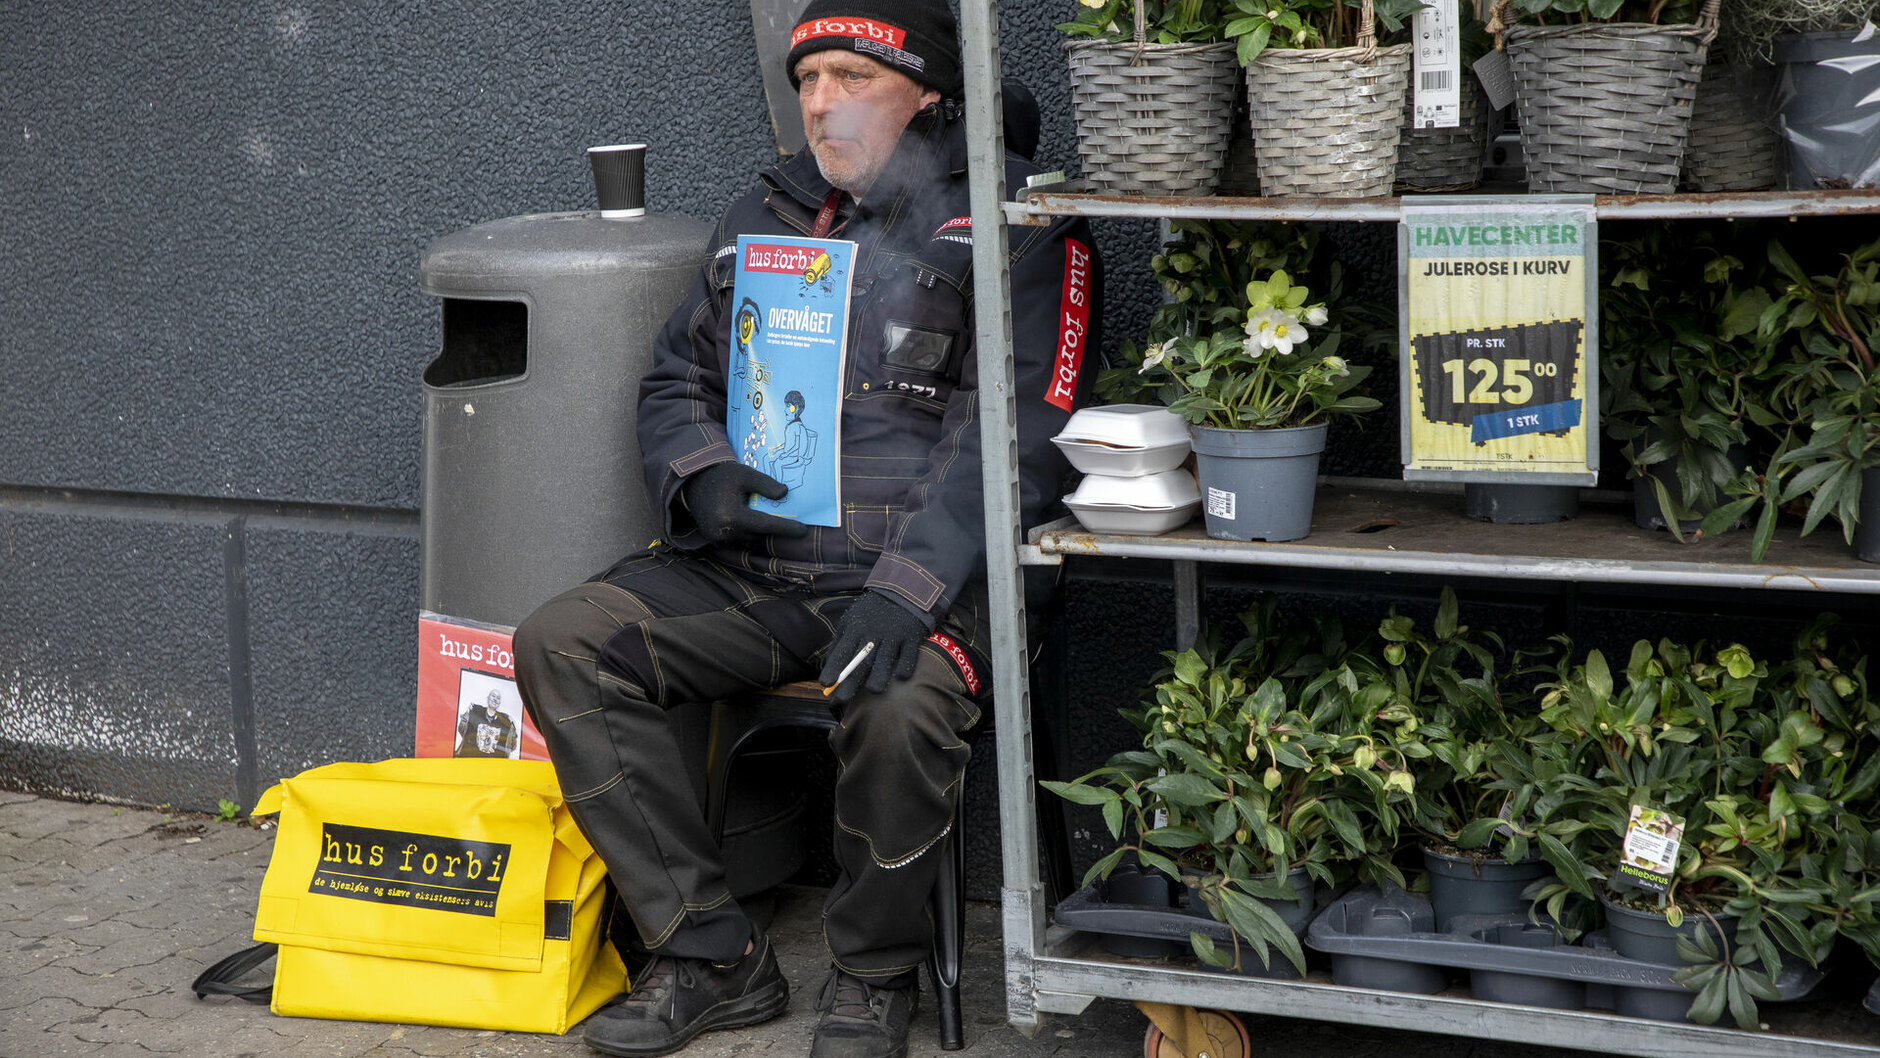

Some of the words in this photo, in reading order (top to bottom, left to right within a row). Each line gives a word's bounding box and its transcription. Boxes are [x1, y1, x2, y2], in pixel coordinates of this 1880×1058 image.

[811, 20, 896, 44] forbi
[1416, 225, 1577, 246] HAVECENTER
[748, 247, 771, 267] hus
[1424, 262, 1508, 276] JULEROSE
[1514, 262, 1518, 275] I
[1523, 260, 1570, 275] KURV
[1070, 246, 1089, 307] hus
[768, 305, 834, 334] OVERVÅGET
[1054, 311, 1084, 401] forbi
[1466, 338, 1483, 348] PR.
[1485, 338, 1506, 348] STK
[1442, 358, 1534, 405] 125
[1507, 418, 1514, 428] 1
[1516, 414, 1540, 427] STK
[440, 633, 483, 661] hus
[950, 646, 978, 691] forbi
[323, 832, 384, 866] hus
[399, 844, 502, 882] forbi
[1621, 865, 1669, 885] Helleborus
[314, 877, 326, 886] de
[329, 879, 369, 893] hjemløse
[373, 886, 385, 897] og
[474, 899, 494, 909] avis
